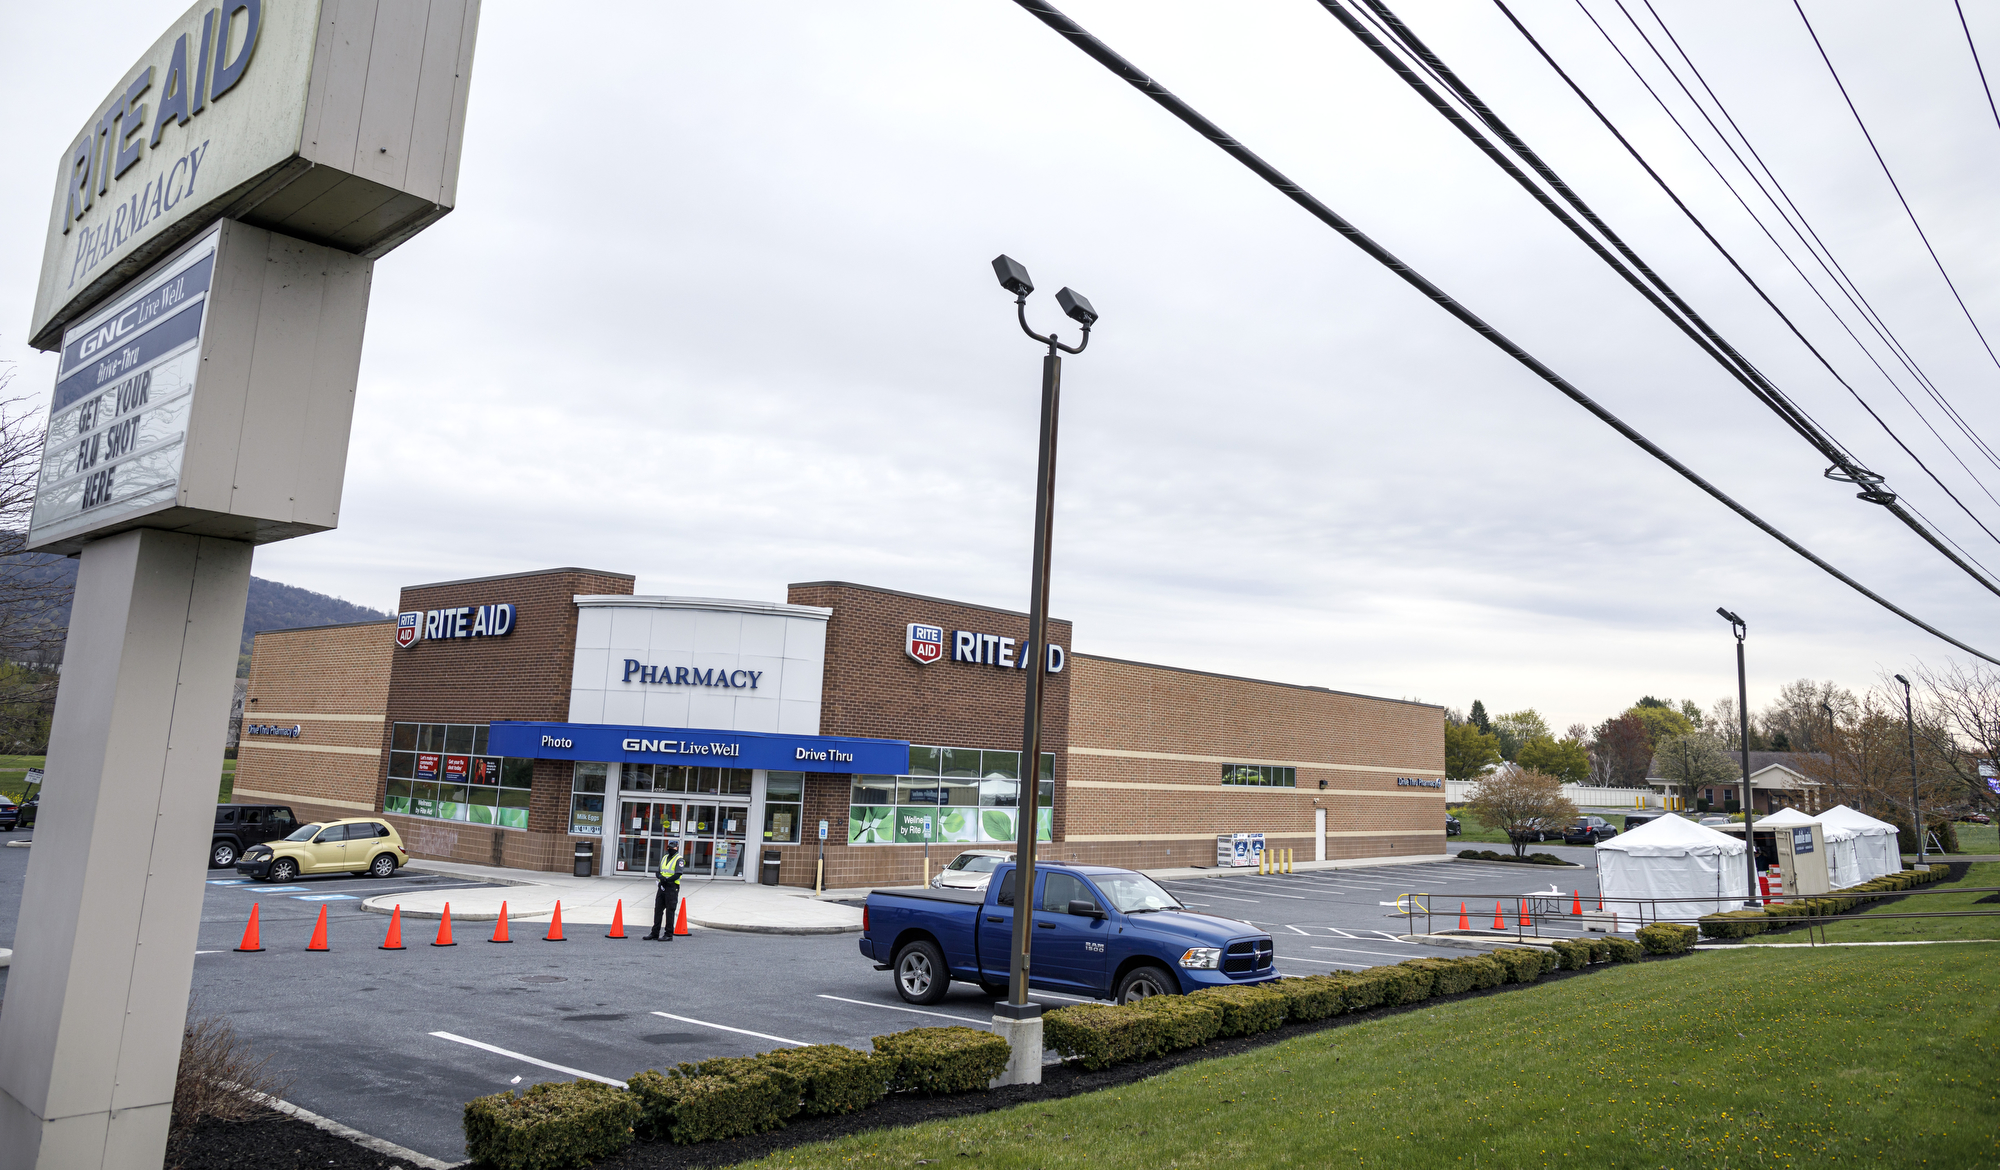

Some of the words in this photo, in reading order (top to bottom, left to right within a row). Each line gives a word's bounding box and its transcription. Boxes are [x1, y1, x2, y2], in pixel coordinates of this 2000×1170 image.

[63, 65, 152, 235] RITE
[150, 0, 262, 149] AID
[67, 139, 210, 290] PHARMACY
[80, 306, 138, 359] GNC
[138, 297, 160, 325] Live
[97, 346, 140, 384] Drive-Thru
[78, 395, 102, 434] GET
[115, 370, 150, 417] YOUR
[76, 432, 100, 473] FLU
[105, 414, 141, 461] SHOT
[82, 466, 116, 510] HERE
[400, 614, 415, 626] RITE
[424, 607, 474, 639] RITE
[472, 603, 516, 637] AID
[399, 629, 412, 641] AID
[916, 627, 939, 641] RITE
[916, 643, 936, 657] AID
[953, 630, 1015, 667] RITE
[248, 724, 259, 734] Drive
[259, 724, 270, 735] Thru
[270, 725, 293, 738] Pharmacy
[541, 735, 573, 749] Photo
[622, 738, 678, 753] GNC
[679, 741, 709, 755] Live
[709, 742, 740, 757] Well
[795, 747, 827, 761] Drive
[827, 749, 853, 762] Thru
[588, 814, 600, 822] Eggs
[904, 815, 924, 824] Wellne
[900, 826, 908, 836] by
[909, 826, 921, 834] Rite
